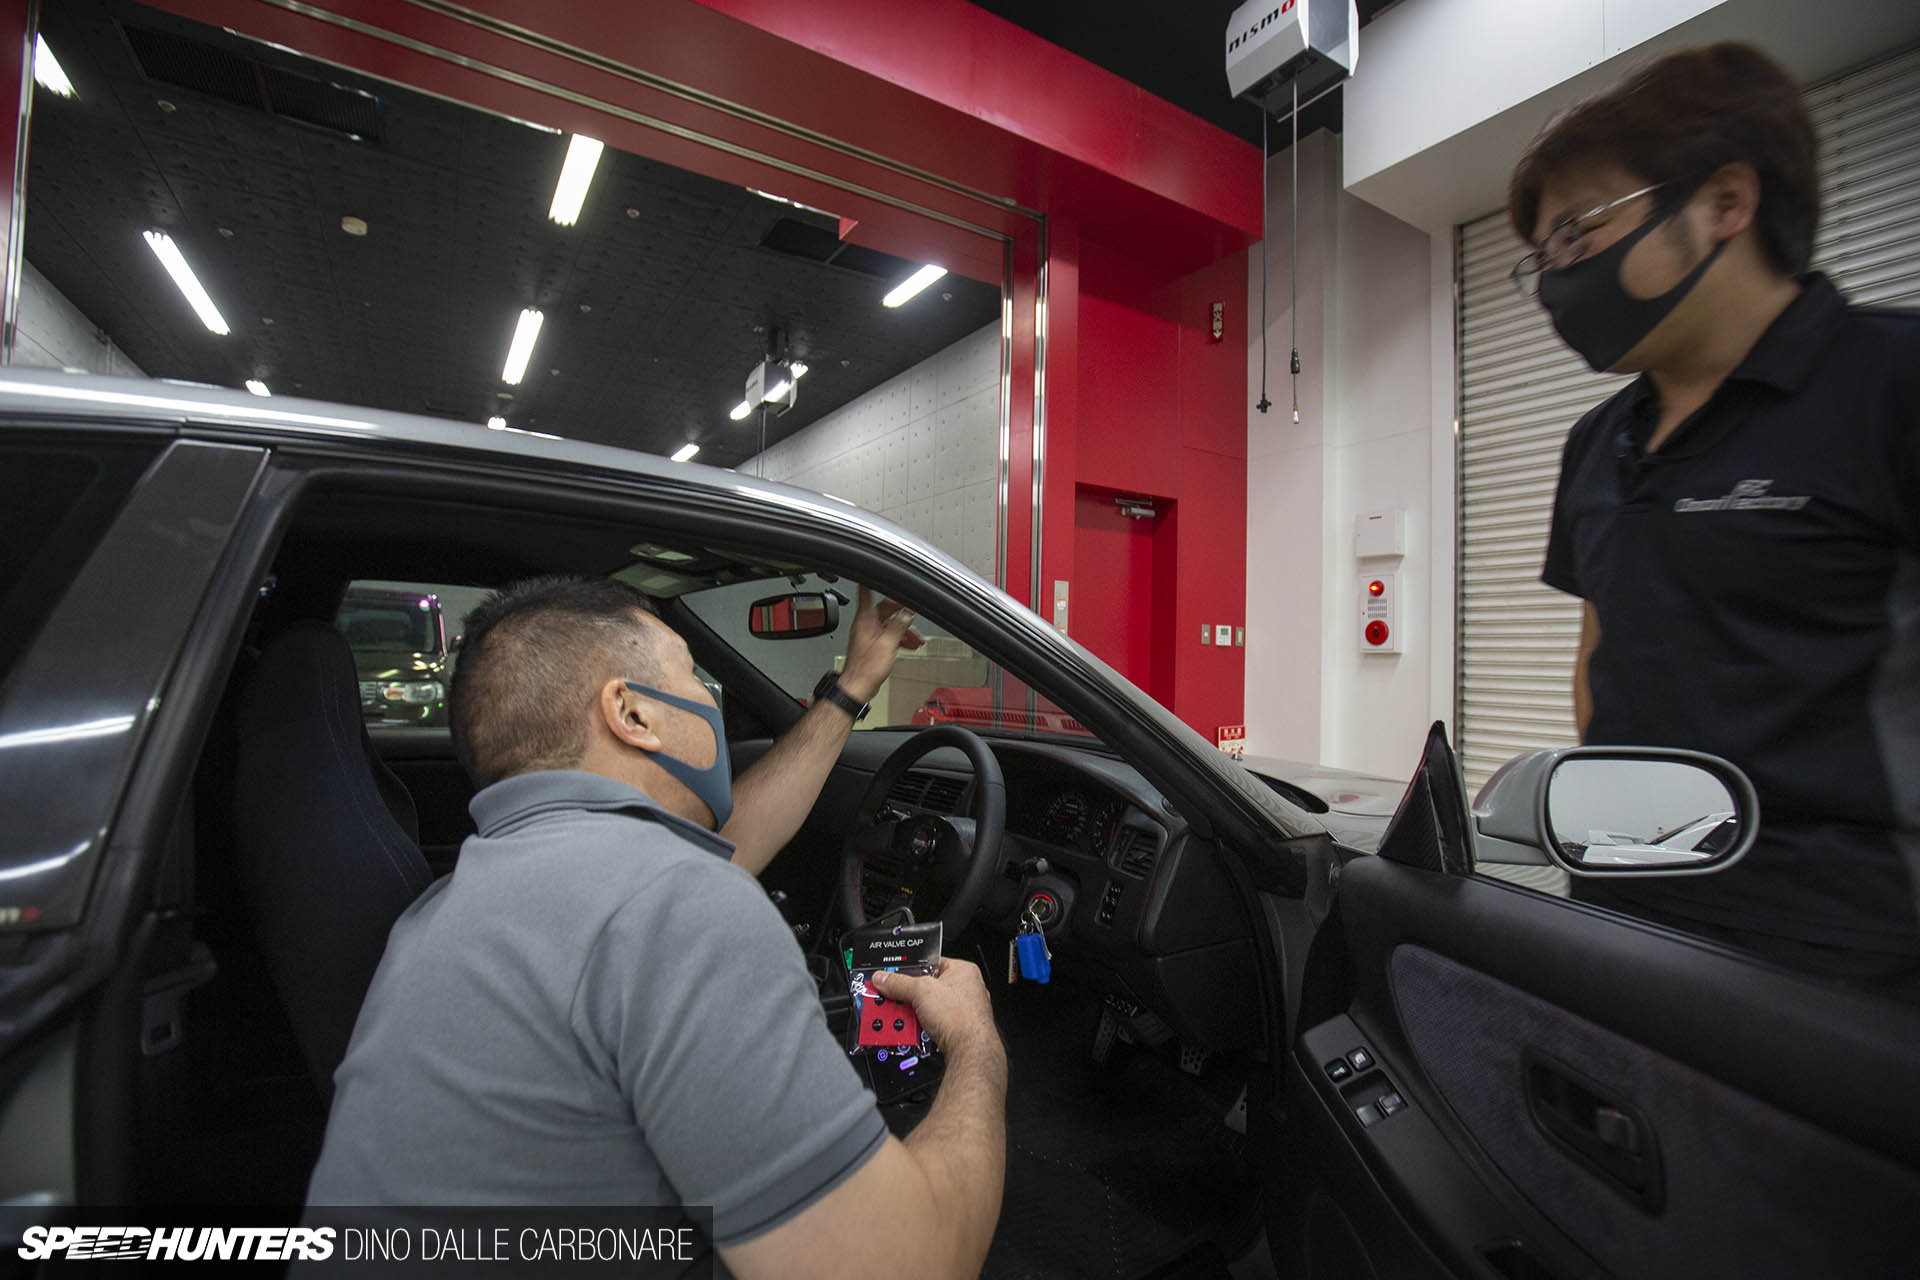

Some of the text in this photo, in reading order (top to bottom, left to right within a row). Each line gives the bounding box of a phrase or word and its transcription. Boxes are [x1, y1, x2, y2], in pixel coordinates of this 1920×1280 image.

[1228, 0, 1295, 53] nismo
[869, 939, 924, 949] AIR VALVE CAP
